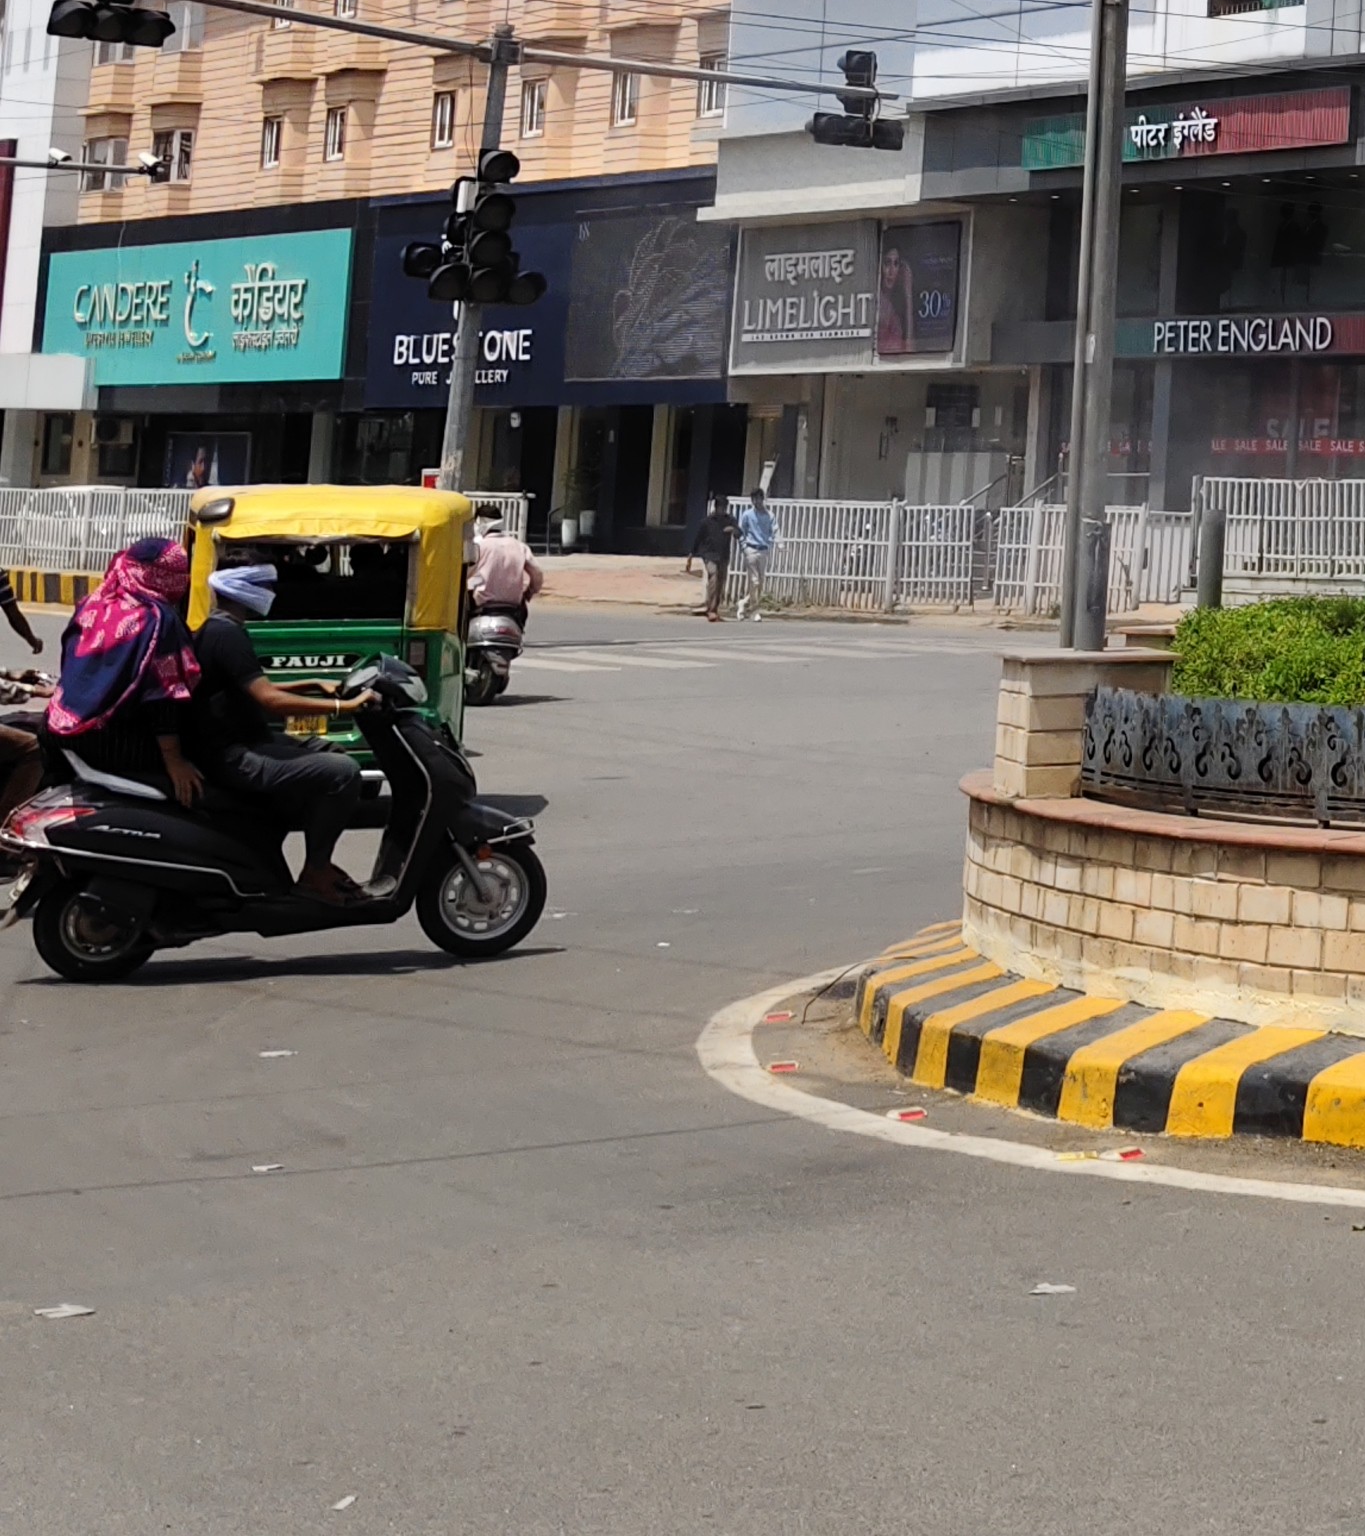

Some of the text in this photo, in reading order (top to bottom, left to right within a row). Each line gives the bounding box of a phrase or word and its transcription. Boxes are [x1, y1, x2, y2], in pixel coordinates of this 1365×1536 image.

[1130, 115, 1168, 148] पीटर
[765, 249, 855, 285] लाइमलाइट
[74, 280, 172, 323] CANDERE
[742, 290, 874, 331] LIMELIGHT
[393, 329, 533, 364] BLUEONE
[1153, 317, 1332, 352] PETER ENGLAND
[412, 369, 508, 385] PURE JLLERY
[1266, 439, 1288, 451] SALE
[1330, 440, 1354, 452] SALE
